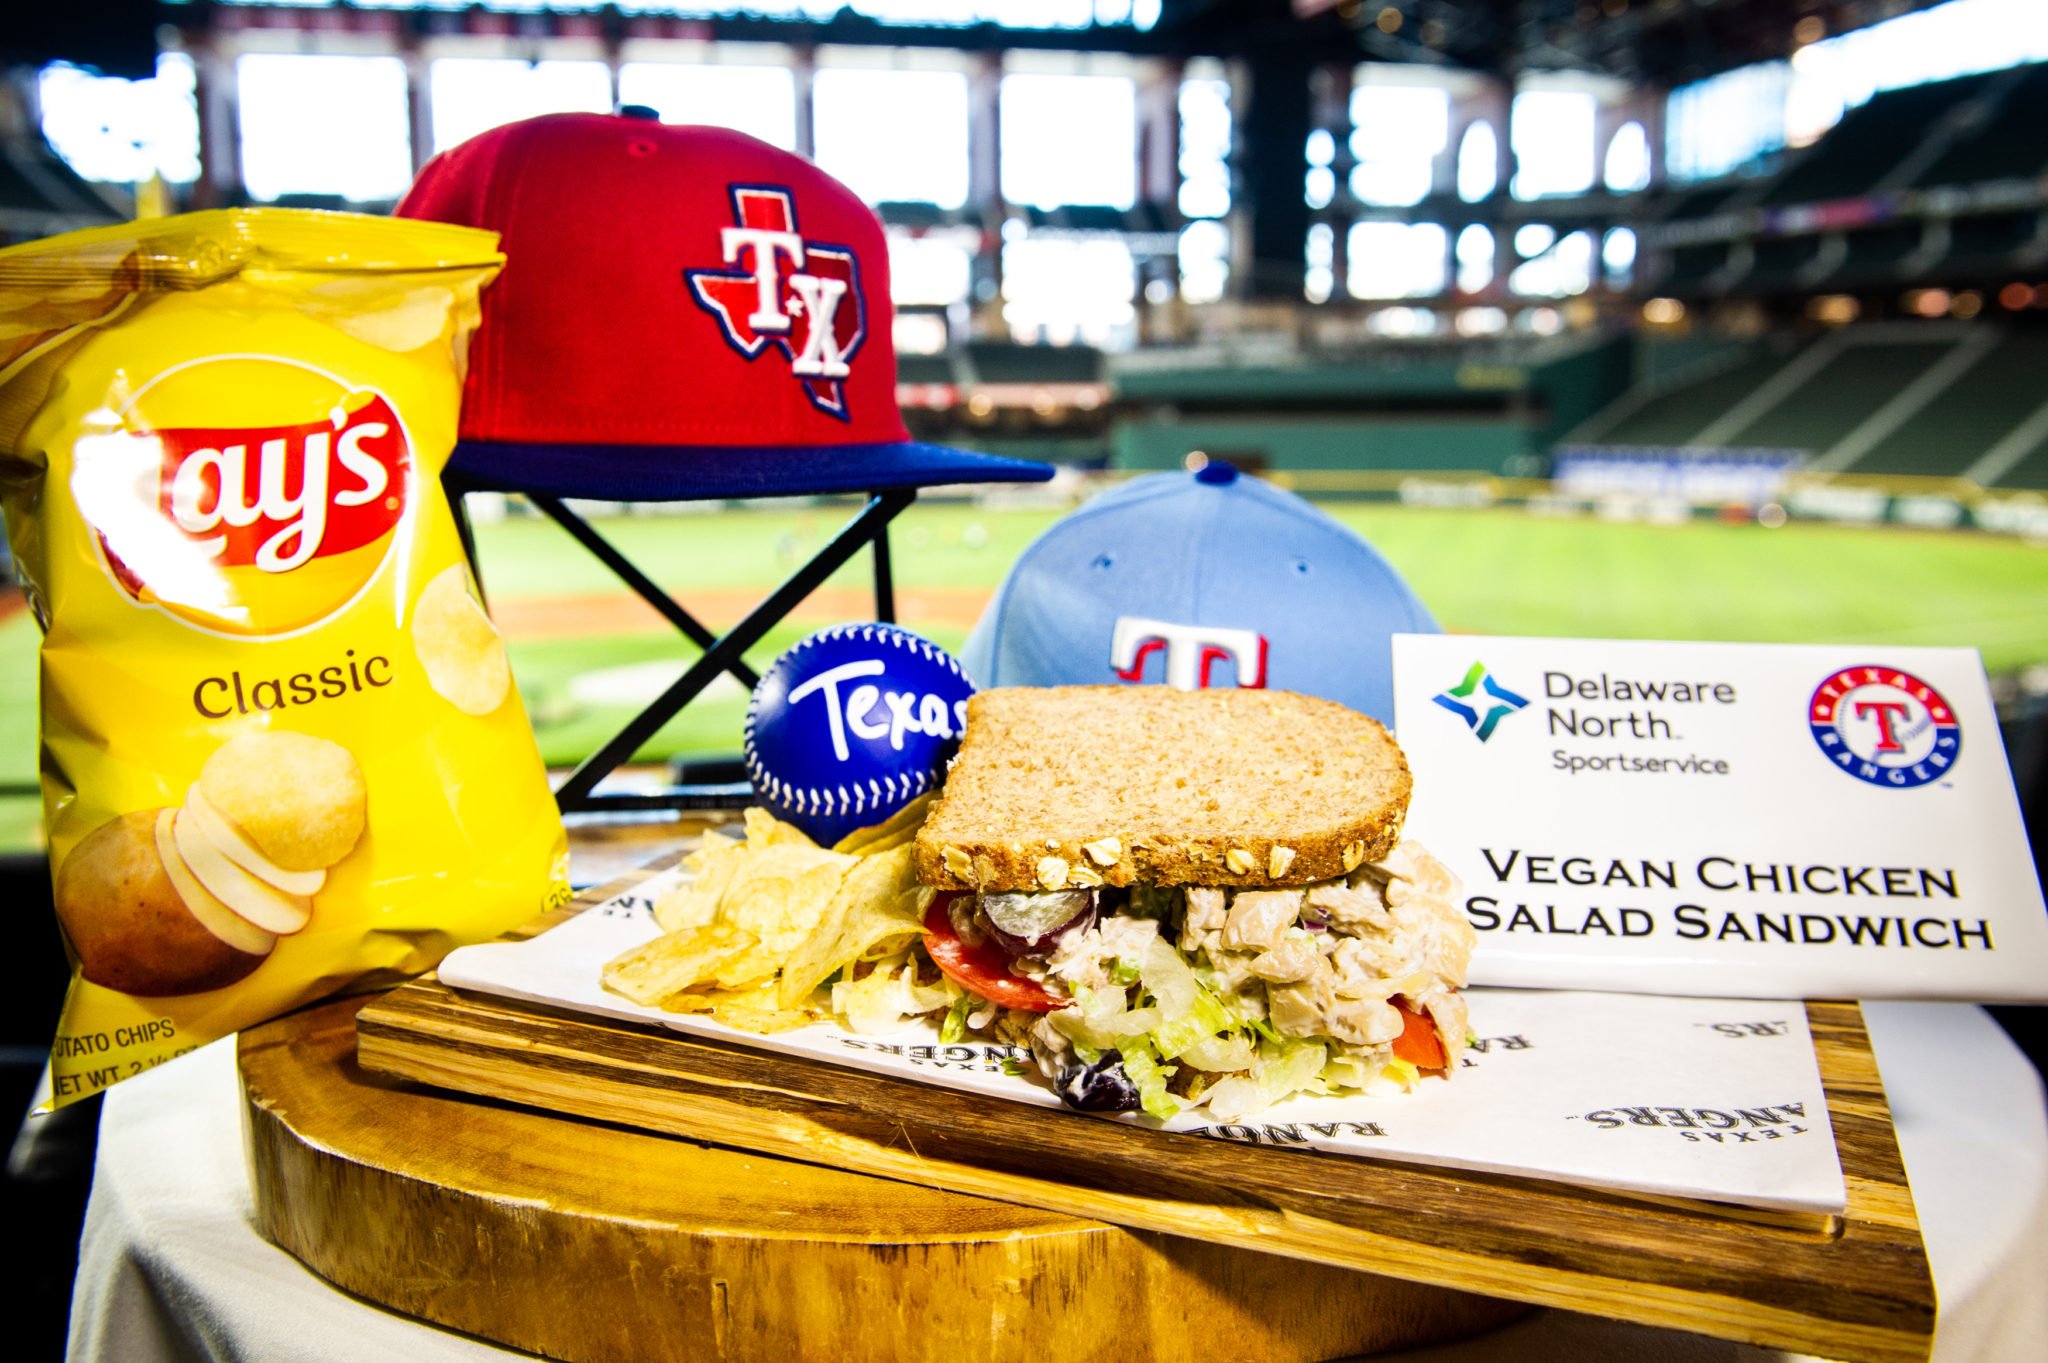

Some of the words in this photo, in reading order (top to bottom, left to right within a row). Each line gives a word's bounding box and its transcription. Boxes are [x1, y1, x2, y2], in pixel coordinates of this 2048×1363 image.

[100, 405, 390, 573] ay's
[193, 649, 393, 719] Classic
[1544, 671, 1736, 704] Delaware
[1547, 707, 1673, 740] North
[1853, 702, 1911, 752] T
[1552, 749, 1730, 775] Sportservice
[1820, 732, 1956, 785] RANGERS
[1481, 848, 1678, 889] VEGAN
[1696, 857, 1961, 898] CHICKEN
[1465, 896, 1655, 938] SALAD
[1674, 904, 1996, 950] SANDWICH
[54, 1032, 110, 1058] OTATO
[115, 1018, 176, 1048] CHIPS
[910, 1058, 1000, 1073] EXAS
[1584, 1102, 1807, 1130] ANGERS
[1679, 1125, 1809, 1144] TEXAS
